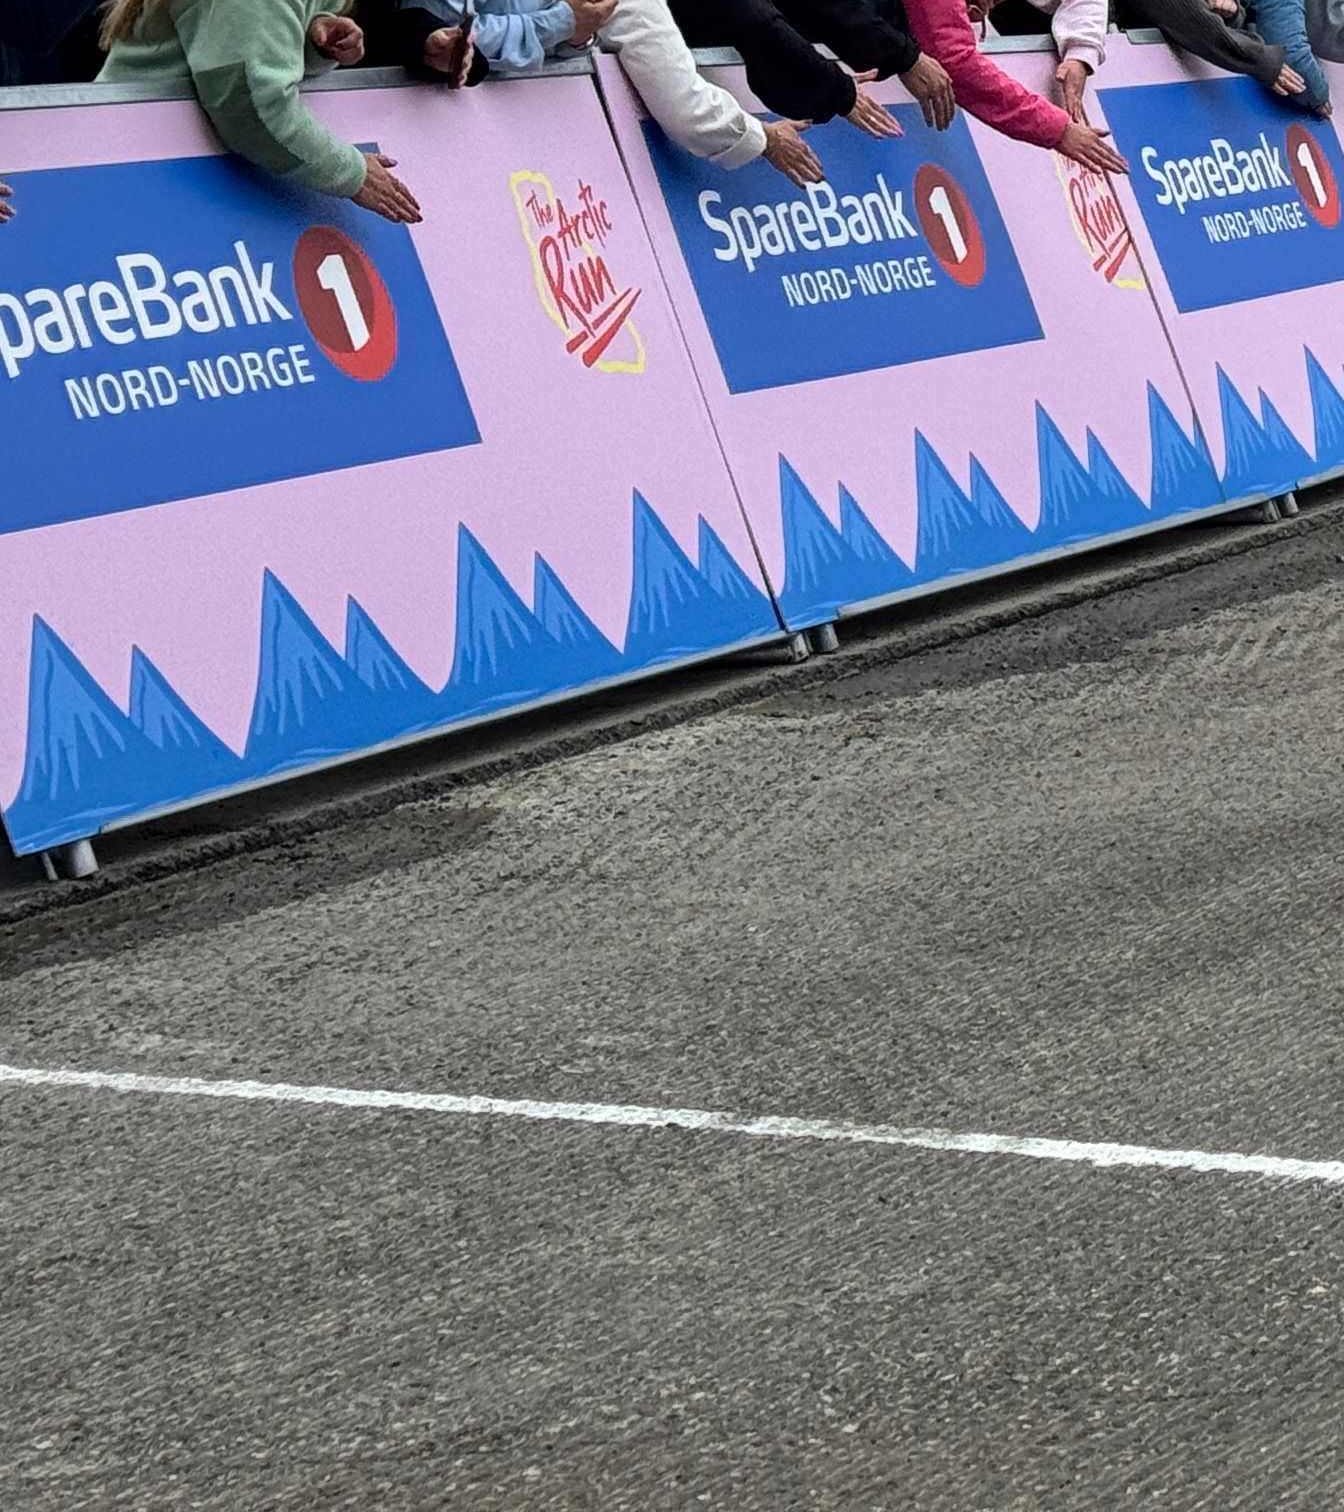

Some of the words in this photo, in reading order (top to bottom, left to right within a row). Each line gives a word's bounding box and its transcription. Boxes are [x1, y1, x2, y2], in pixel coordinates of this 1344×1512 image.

[1141, 131, 1294, 215] SpareBank
[1296, 141, 1328, 209] 1
[525, 189, 554, 229] The
[556, 178, 612, 262] Arctic
[699, 173, 918, 272] SpareBank
[929, 186, 968, 265] 1
[1202, 200, 1307, 244] NORD-NORGE
[0, 240, 293, 380] pareBank
[316, 253, 371, 352] 1
[539, 235, 617, 338] Run
[781, 254, 936, 309] NORD-NORGE
[64, 343, 316, 421] NORD-NORGE
